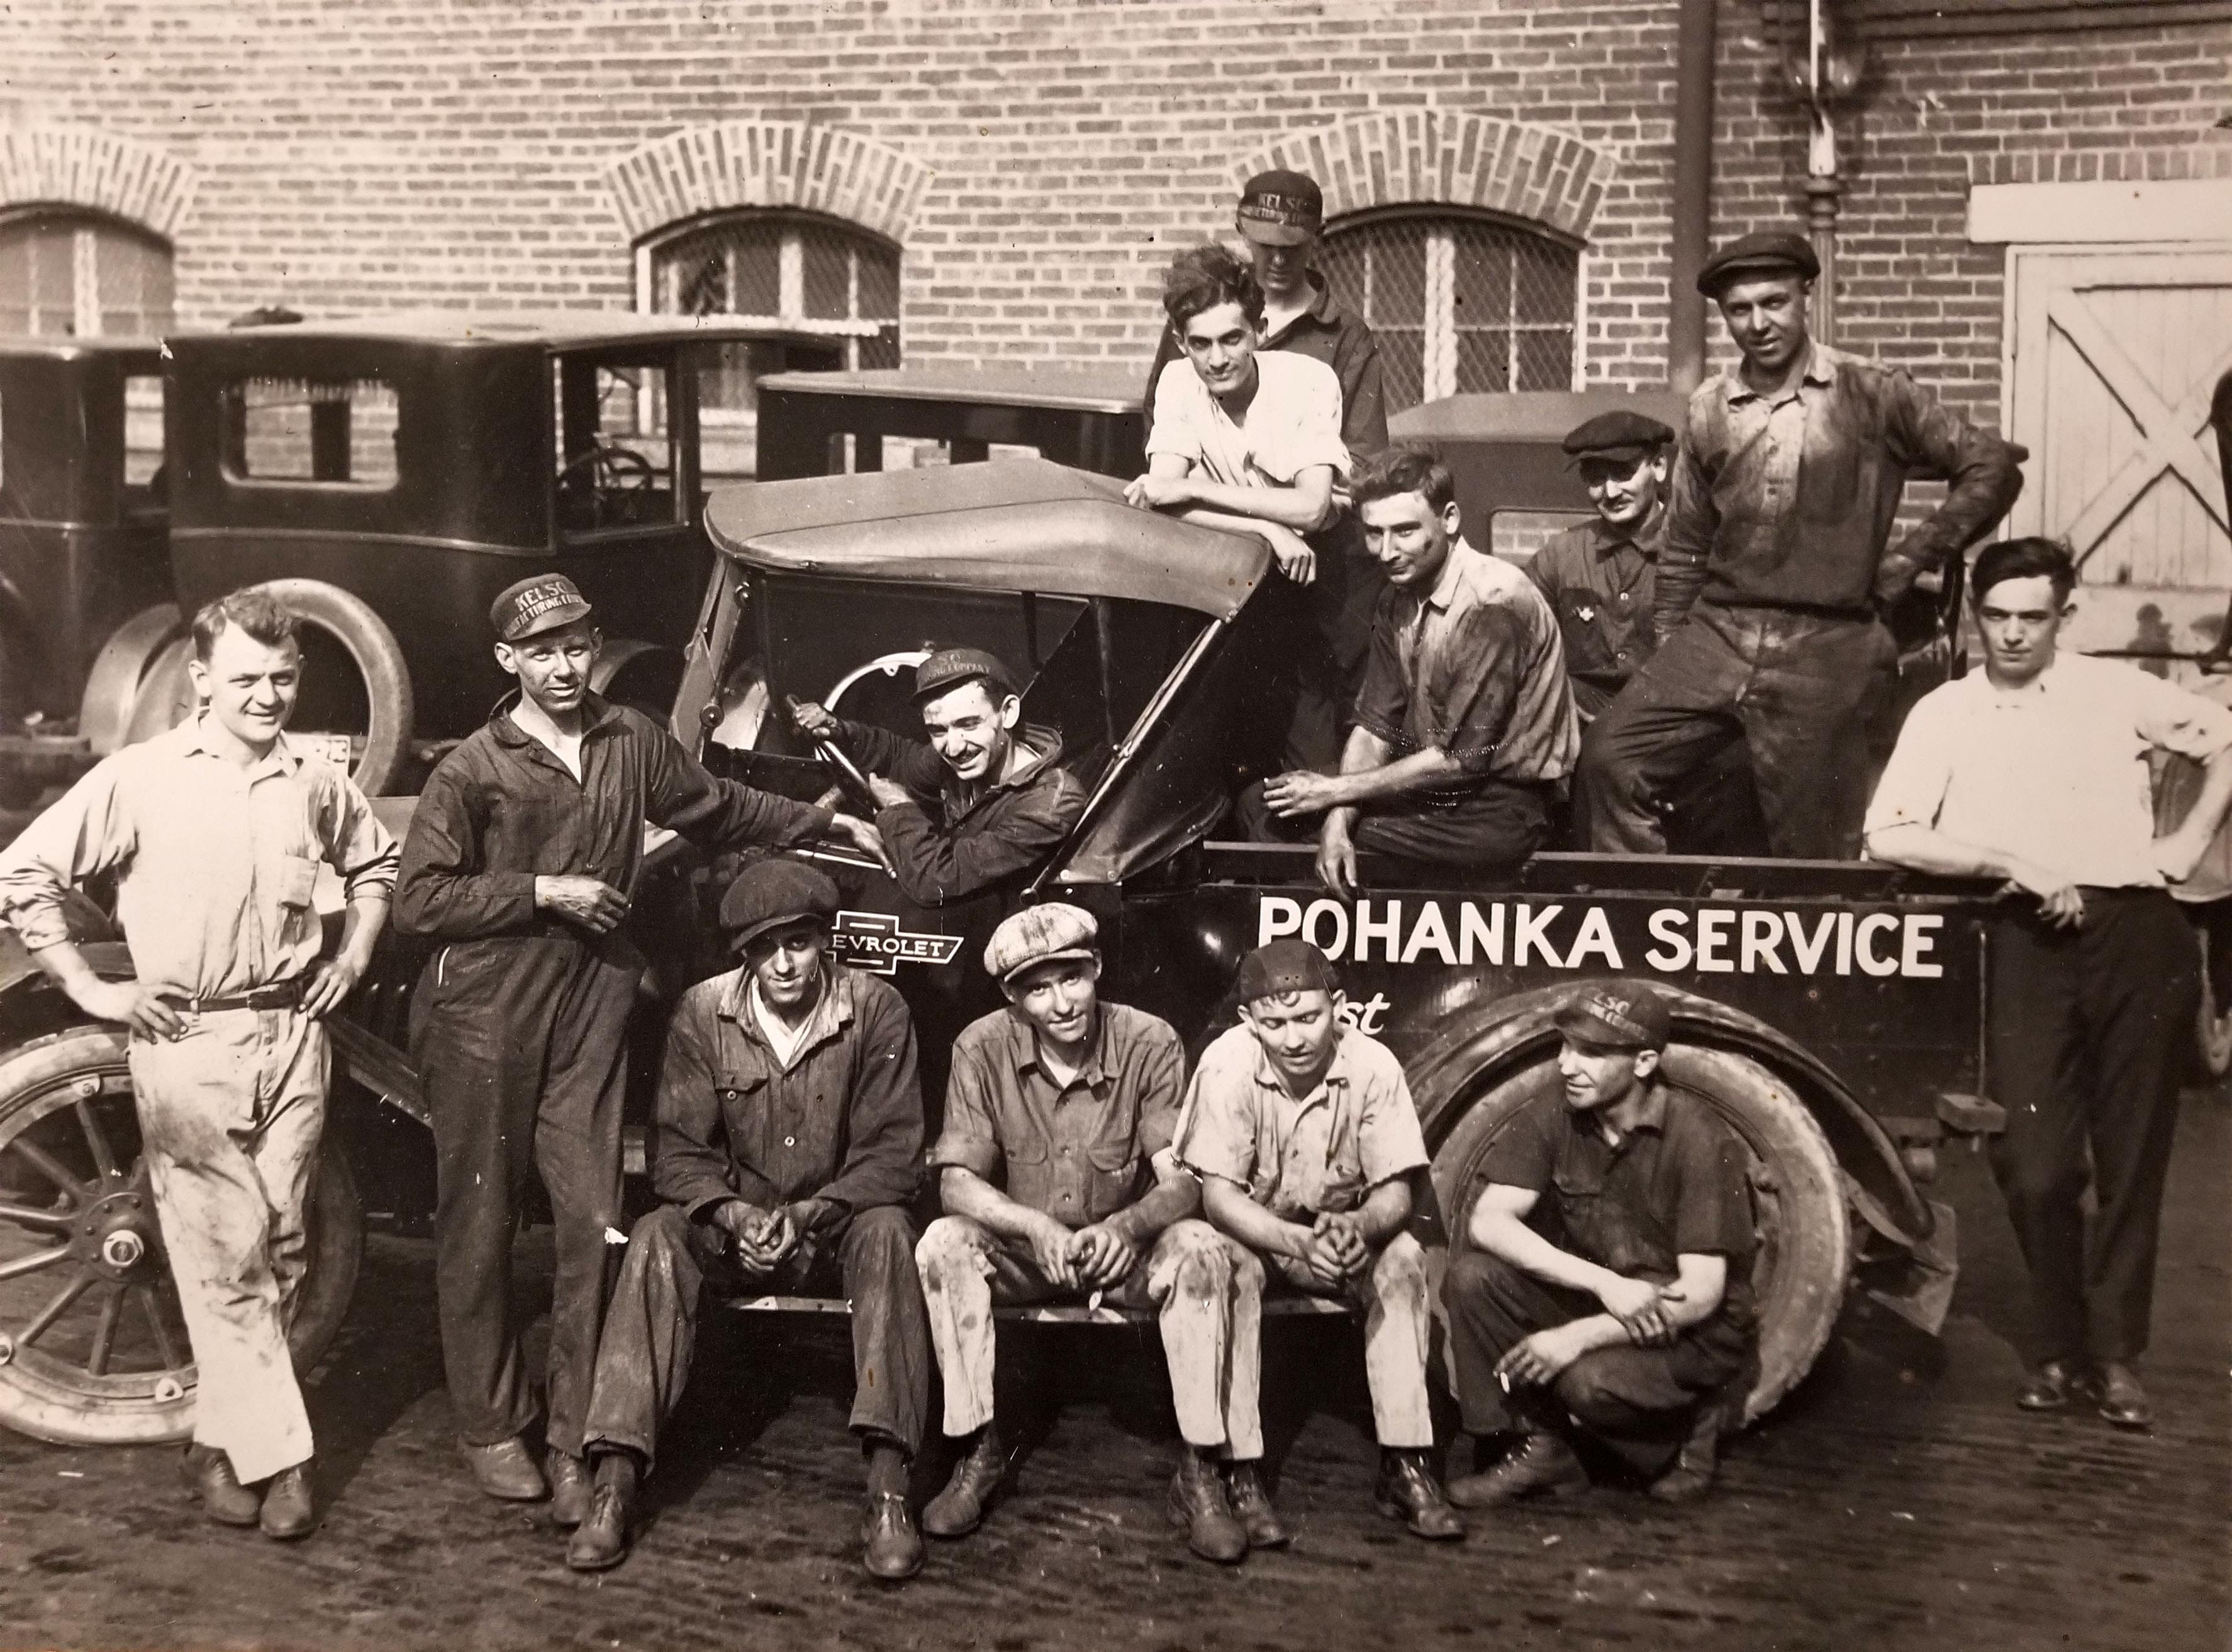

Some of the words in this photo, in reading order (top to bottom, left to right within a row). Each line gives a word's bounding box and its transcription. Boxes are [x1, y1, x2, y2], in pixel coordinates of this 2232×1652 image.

[515, 581, 568, 611] KELSO
[832, 934, 944, 957] EVROLET
[1259, 896, 1623, 969] POHANKA
[1645, 908, 1943, 978] SERVICE
